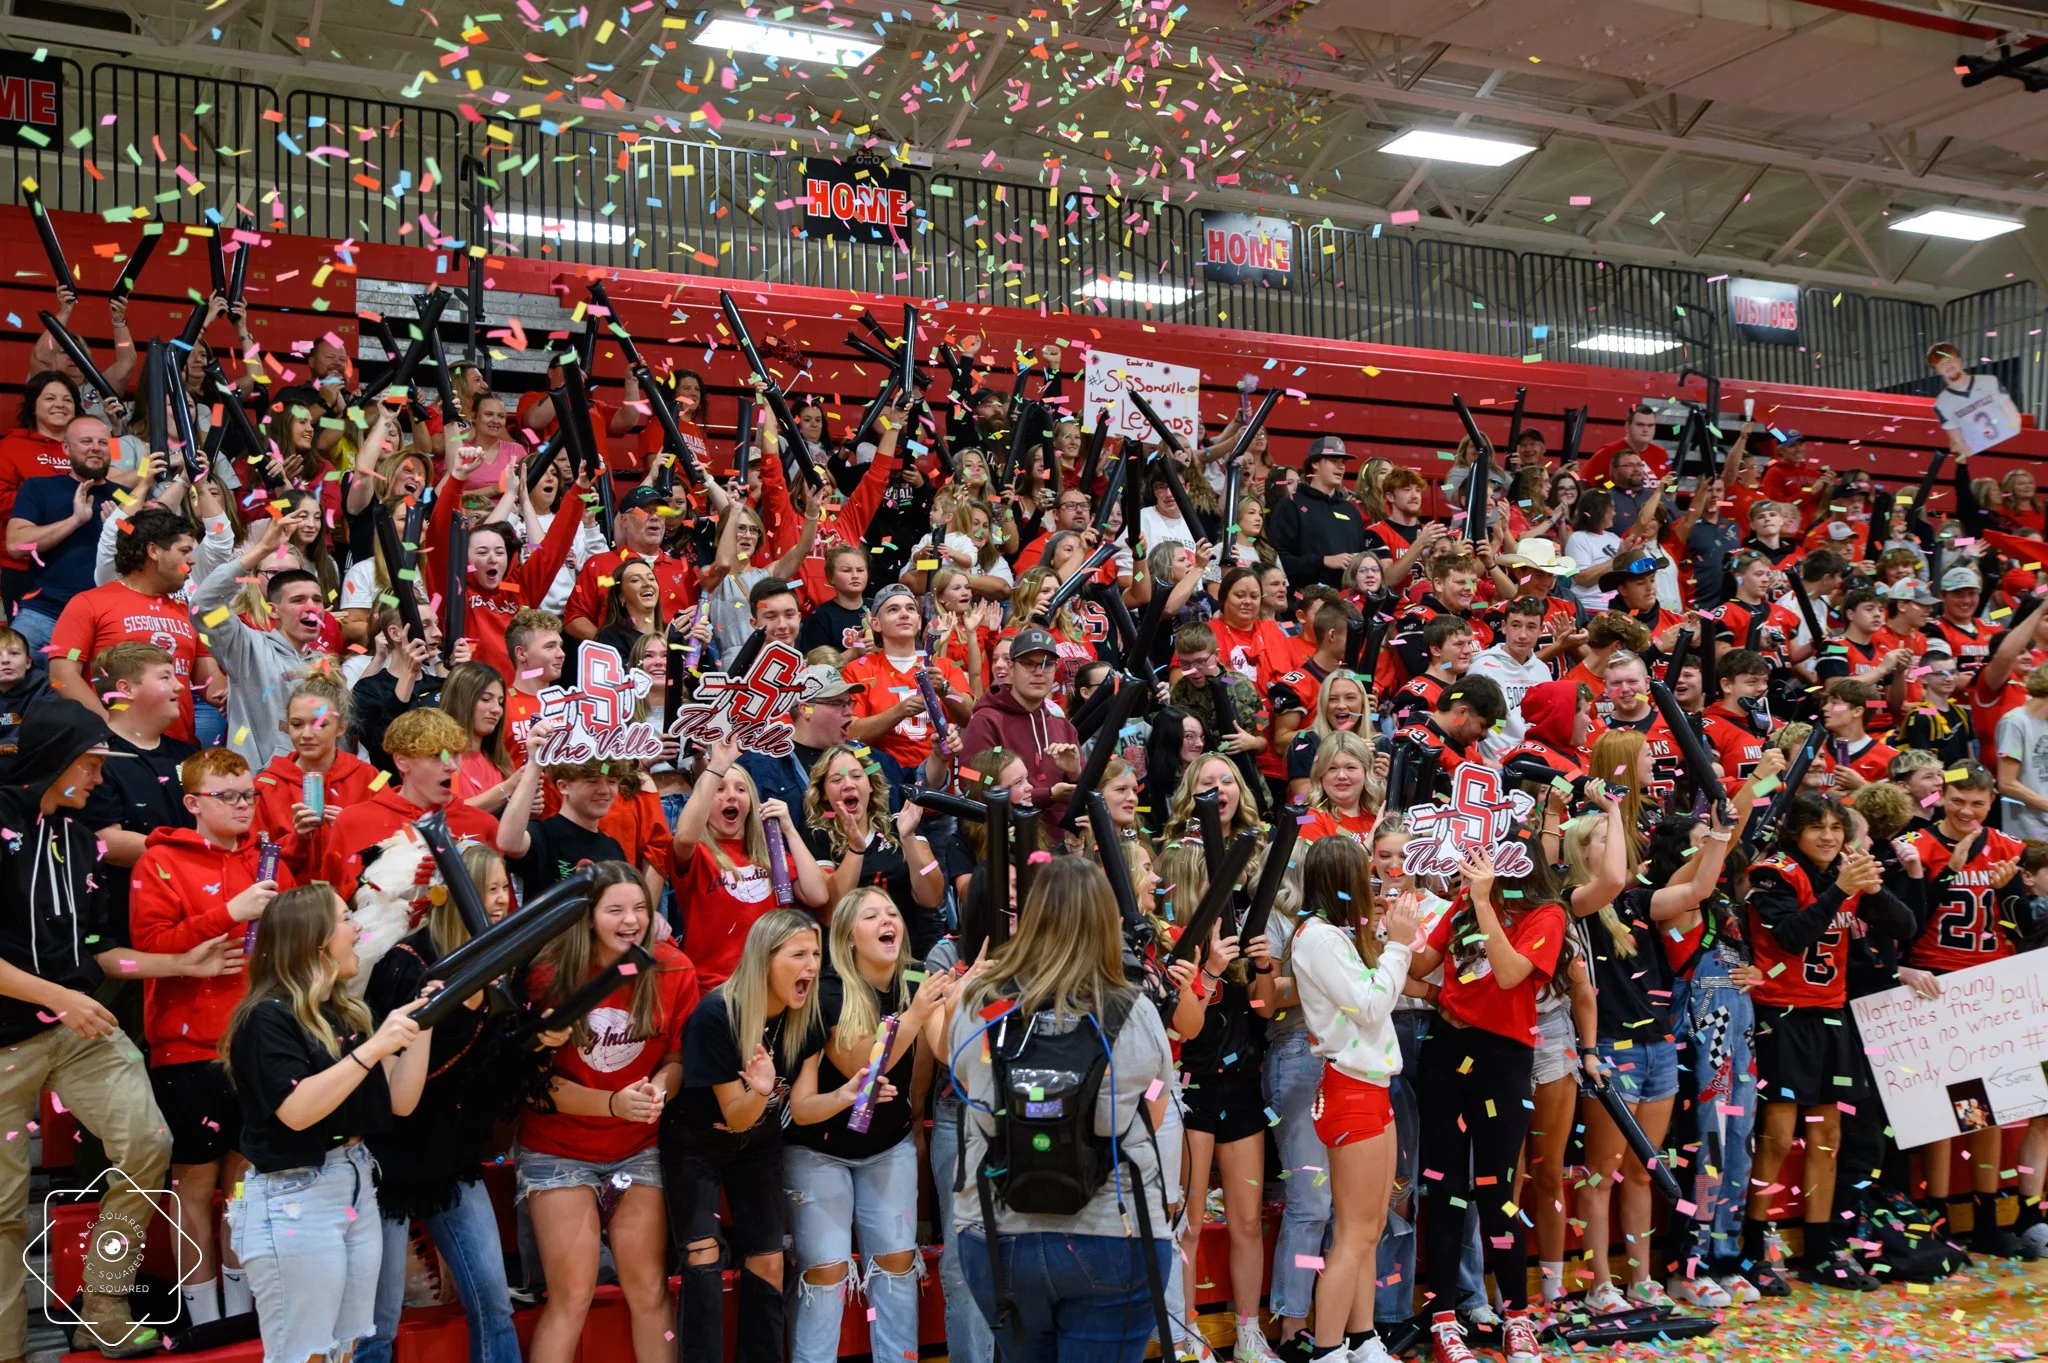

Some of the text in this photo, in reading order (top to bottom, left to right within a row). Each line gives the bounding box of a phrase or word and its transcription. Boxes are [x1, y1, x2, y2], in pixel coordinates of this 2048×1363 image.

[0, 75, 56, 125] ME
[807, 178, 907, 227] HOME
[1208, 228, 1290, 272] HOME
[1733, 295, 1798, 331] VISITORS
[37, 453, 72, 466] Sisson
[124, 615, 193, 639] SISSONVILLE
[672, 707, 723, 742] The
[539, 728, 591, 763] The
[1121, 732, 1145, 755] ANS
[1650, 740, 1670, 755] ANS
[1743, 746, 1762, 759] IND
[1406, 841, 1457, 873] The
[1828, 912, 1853, 929] ANS
[1938, 888, 1998, 952] 21
[1803, 932, 1842, 986] 5
[1948, 999, 1983, 1018] the
[2000, 974, 2042, 1004] ball
[1939, 1025, 1960, 1043] no
[1966, 1008, 2023, 1034] where
[1884, 1060, 1941, 1097] Randy
[1948, 1038, 2015, 1073] Orton
